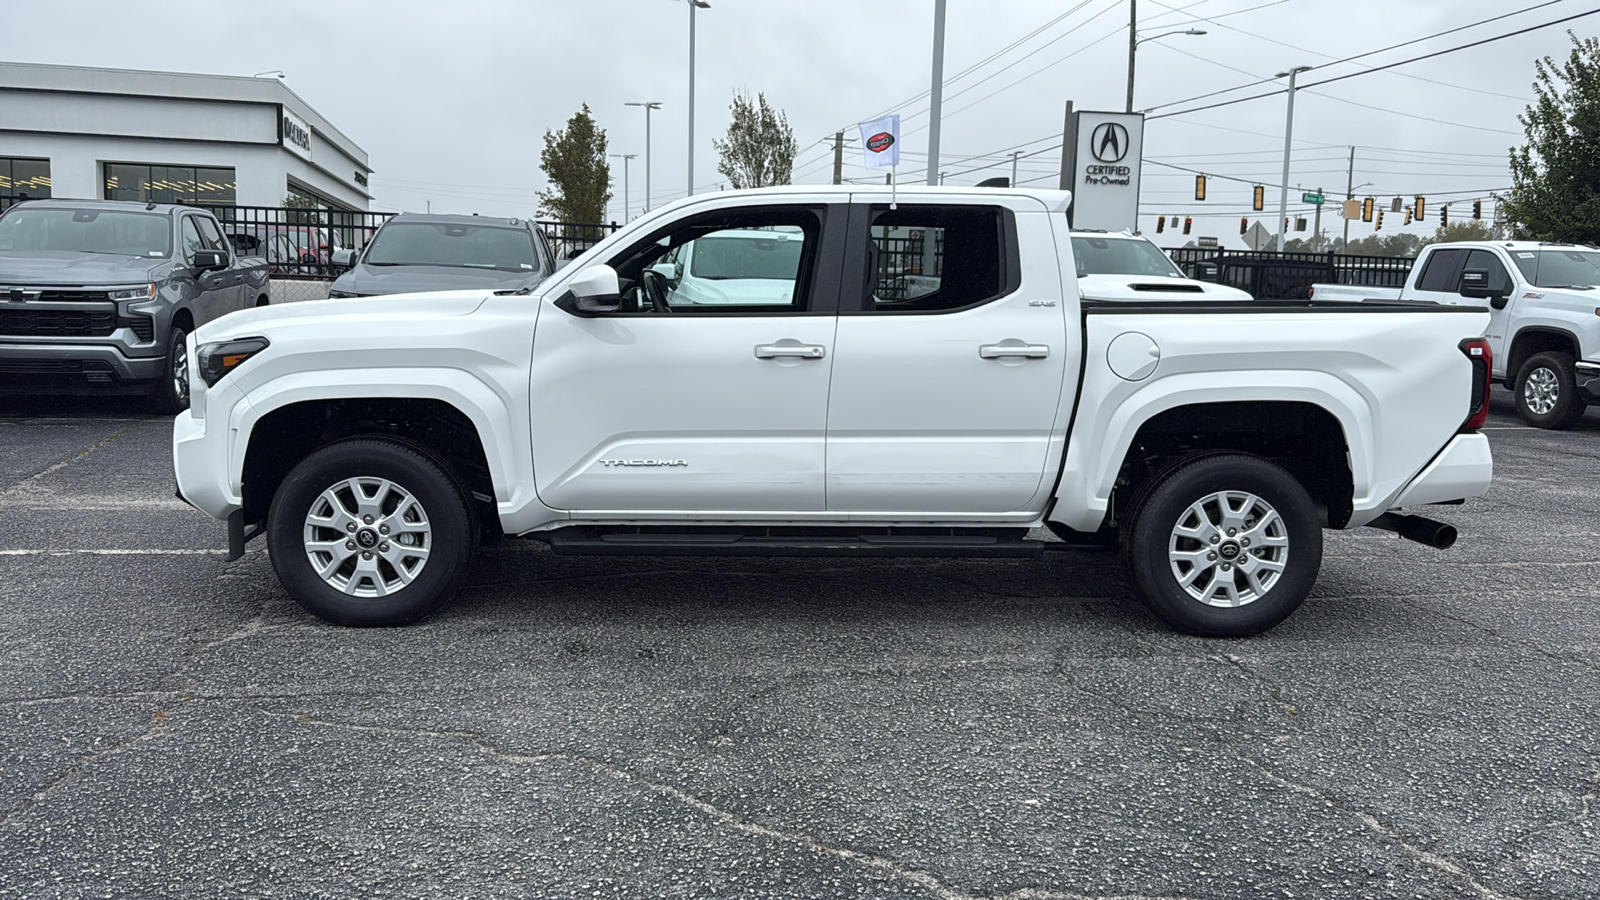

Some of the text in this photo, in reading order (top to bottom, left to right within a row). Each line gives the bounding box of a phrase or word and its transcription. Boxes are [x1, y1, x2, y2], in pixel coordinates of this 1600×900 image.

[1086, 164, 1131, 175] CERTIFIED
[1085, 175, 1130, 186] Pre-Owned
[599, 459, 688, 467] TACOMA
